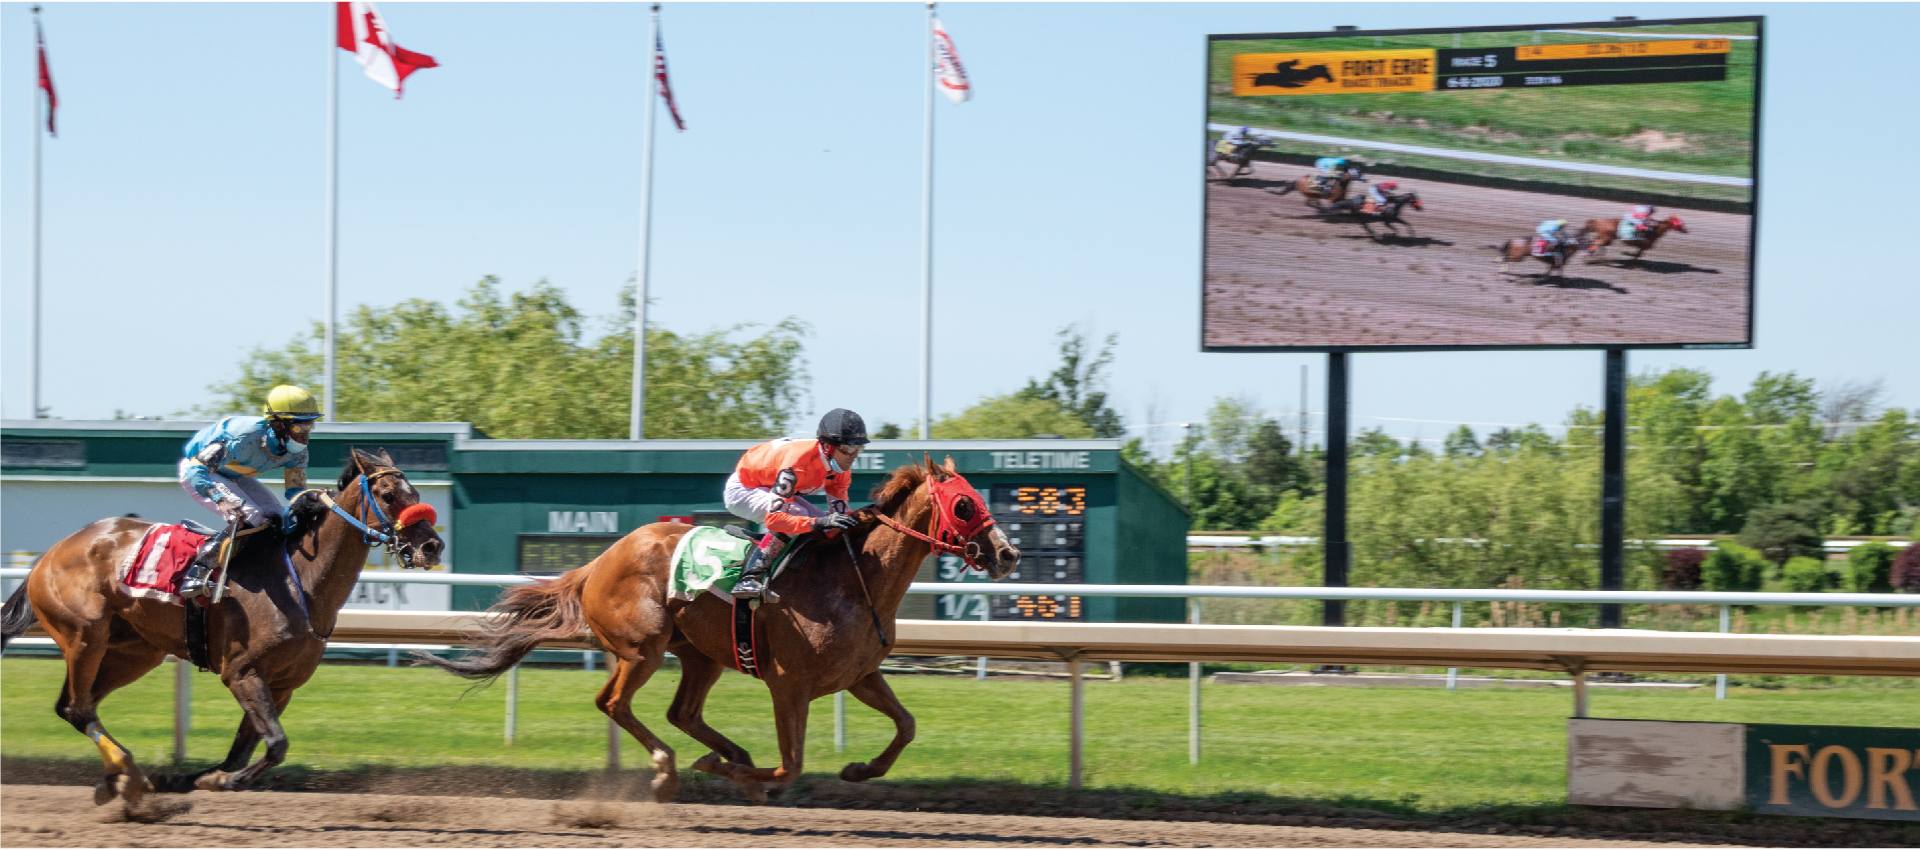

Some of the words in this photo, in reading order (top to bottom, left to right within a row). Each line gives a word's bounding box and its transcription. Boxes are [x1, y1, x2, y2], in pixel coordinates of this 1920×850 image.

[1342, 59, 1385, 76] FORT
[1392, 58, 1429, 75] ERIE
[1484, 54, 1498, 68] 5
[1343, 78, 1372, 87] RACE
[1377, 77, 1415, 87] TRACK
[990, 452, 1090, 469] TELETIME
[779, 470, 796, 495] 5
[548, 511, 618, 532] MAIN
[135, 531, 172, 585] 1
[687, 539, 738, 590] 5
[345, 582, 409, 605] ACK
[939, 593, 987, 619] 1/2
[1767, 744, 1920, 810] FOR
